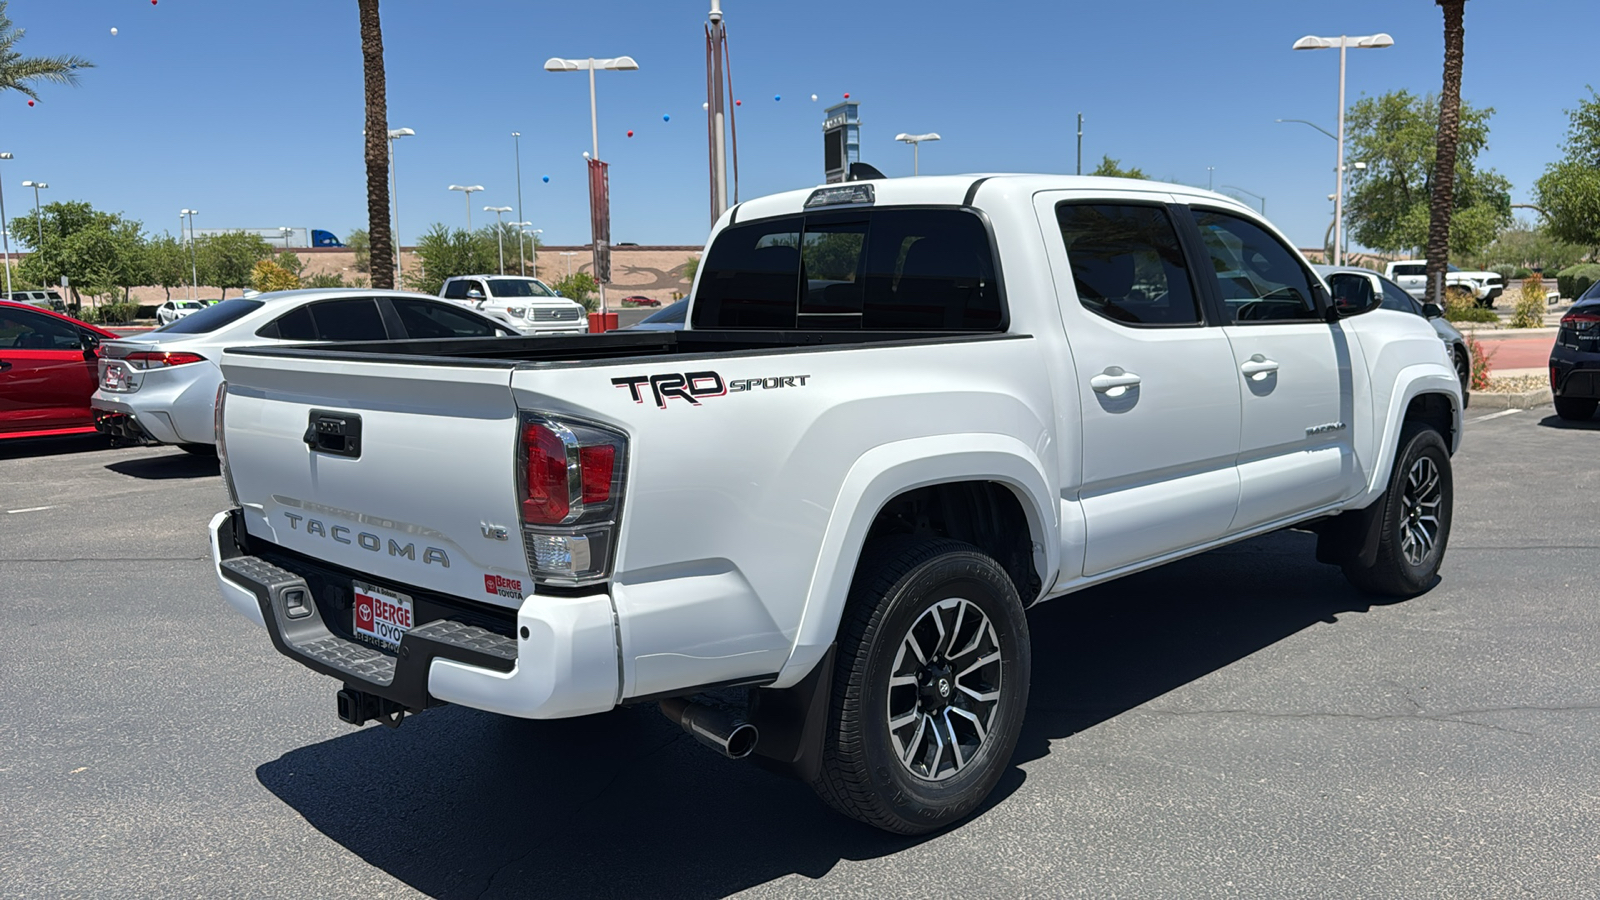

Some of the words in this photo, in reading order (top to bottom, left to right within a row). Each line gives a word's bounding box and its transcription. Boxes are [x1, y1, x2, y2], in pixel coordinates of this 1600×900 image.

[610, 369, 728, 410] TRD
[729, 374, 811, 393] SPORT
[284, 511, 450, 568] TACOMA
[480, 521, 508, 541] V6
[495, 574, 522, 591] BERGE
[498, 589, 524, 600] TOYOTA
[374, 598, 411, 627] BERGE
[375, 621, 405, 641] TOYO
[357, 632, 384, 649] BERGE
[385, 641, 400, 654] TOY
